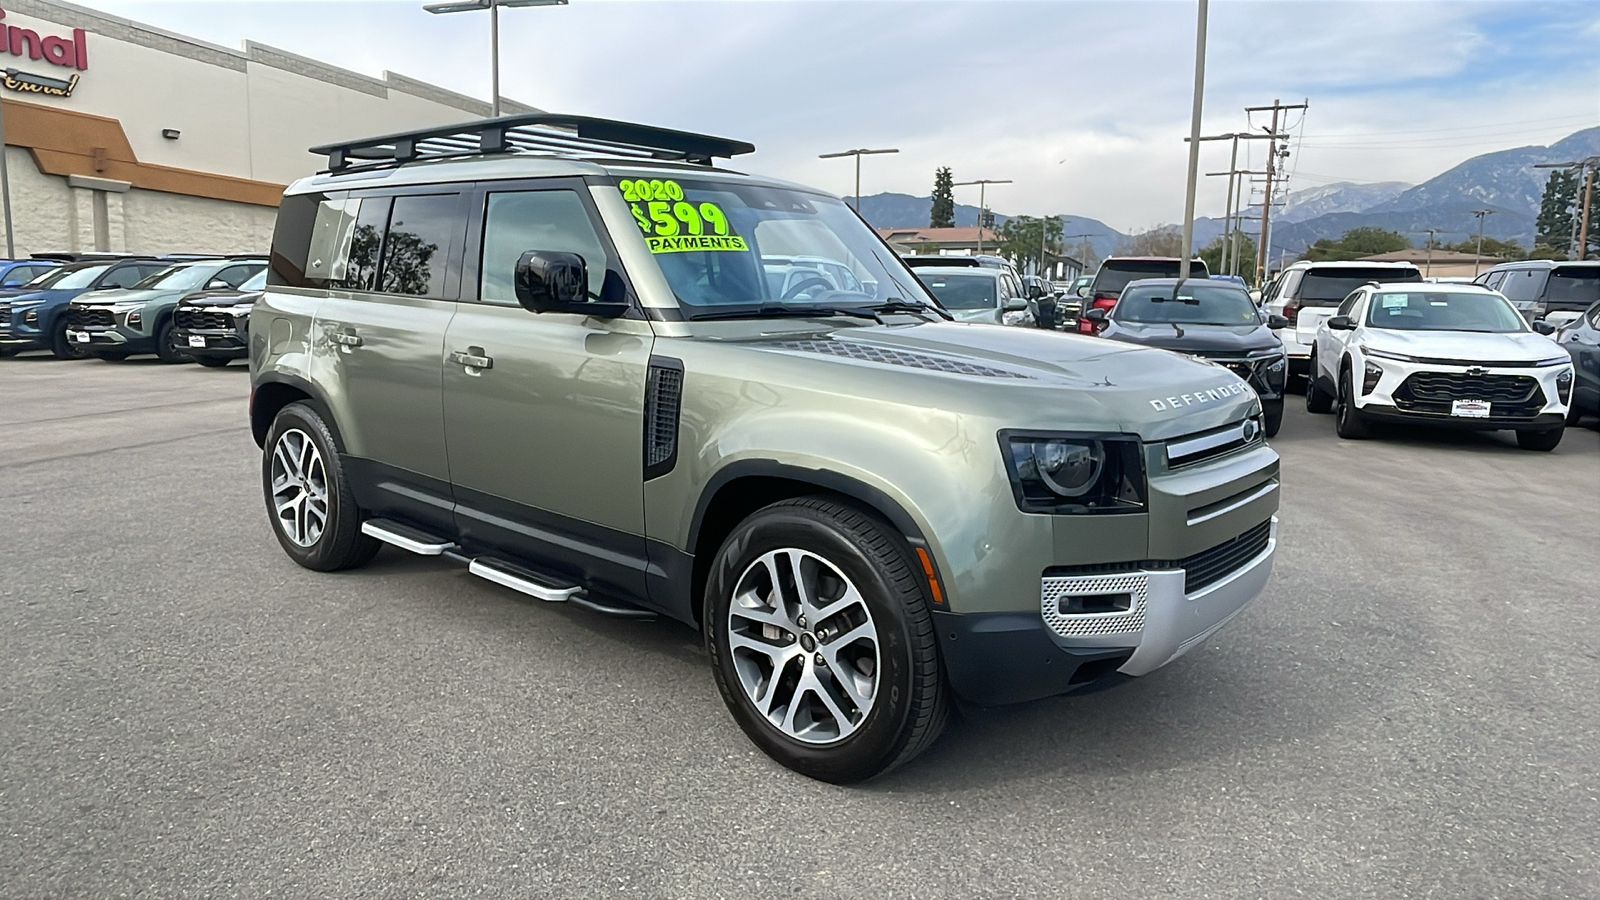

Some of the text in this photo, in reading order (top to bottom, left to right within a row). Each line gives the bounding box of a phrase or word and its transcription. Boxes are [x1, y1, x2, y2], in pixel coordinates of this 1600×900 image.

[619, 179, 684, 202] 2020
[630, 201, 729, 236] $599
[649, 237, 744, 251] PAYMENTS
[1149, 382, 1248, 412] DEFENDER
